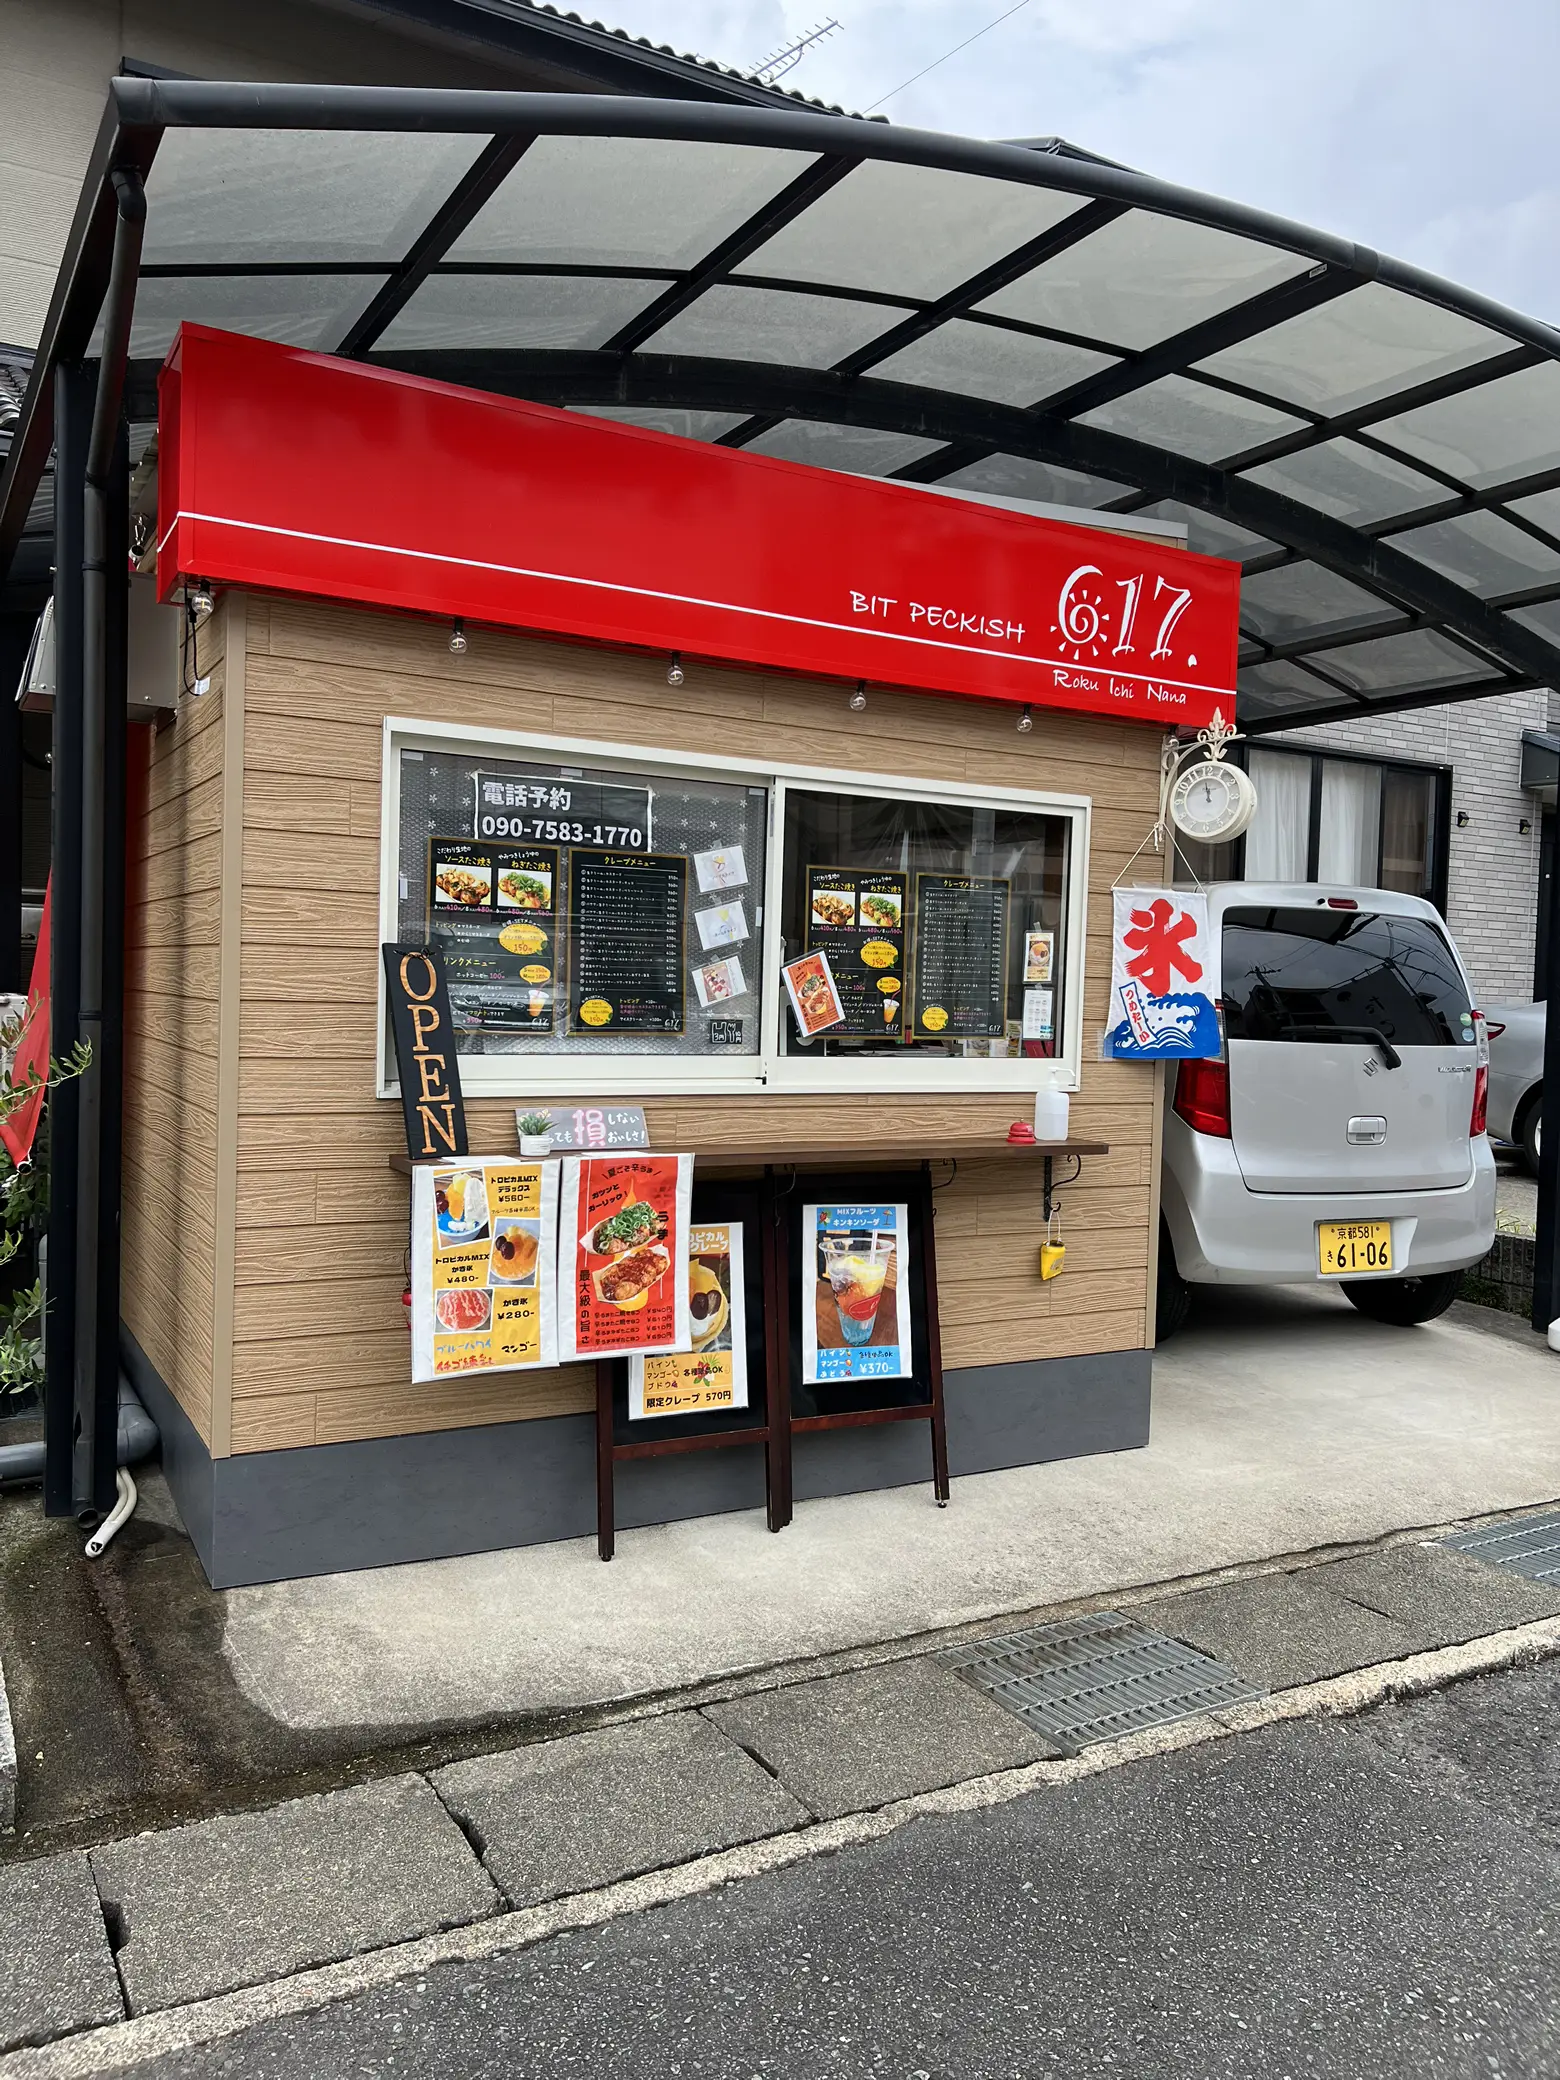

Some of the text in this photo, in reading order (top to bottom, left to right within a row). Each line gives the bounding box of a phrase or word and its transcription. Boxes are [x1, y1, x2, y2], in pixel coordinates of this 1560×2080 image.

[849, 590, 1026, 644] BIT PECKISH
[1052, 669, 1188, 705] Roku Ichi Nana
[1187, 770, 1200, 782] 11
[1201, 766, 1213, 776] 12
[1177, 781, 1189, 794] 10
[482, 781, 572, 811] 電話予約
[482, 815, 642, 848] 090-7583-1770
[444, 855, 492, 867] ソースたこ焼き
[511, 860, 551, 872] ねぎたこ焼き
[604, 856, 656, 867] クレープメニュー
[820, 882, 855, 891] ソースたこ焼き
[870, 885, 901, 894] ねぎたこ焼き
[1123, 898, 1203, 997] 氷
[443, 956, 497, 967] リンクメニュー
[1125, 989, 1150, 1043] つめたーい
[400, 951, 457, 1153] OPEN
[607, 1112, 640, 1125] しない
[490, 1175, 538, 1184] トロピカルMIX
[497, 1185, 530, 1193] デラックス
[836, 1207, 876, 1215] MIXフルーツ
[833, 1218, 881, 1227] キンキンソーダ
[1337, 1226, 1374, 1240] 京都581
[435, 1253, 490, 1265] トロピカルMIX
[1327, 1241, 1388, 1268] き 61-06
[579, 1269, 591, 1344] 最大級の旨さ
[437, 1338, 492, 1354] ブルーハワイ
[501, 1341, 538, 1353] マンゴー
[820, 1349, 846, 1357] パイン
[647, 1361, 671, 1369] パイン
[647, 1371, 672, 1379] マンゴー
[820, 1370, 846, 1378] ぶどう
[648, 1382, 671, 1390] ブドウ
[646, 1390, 731, 1409] 限定クレープ 570円
